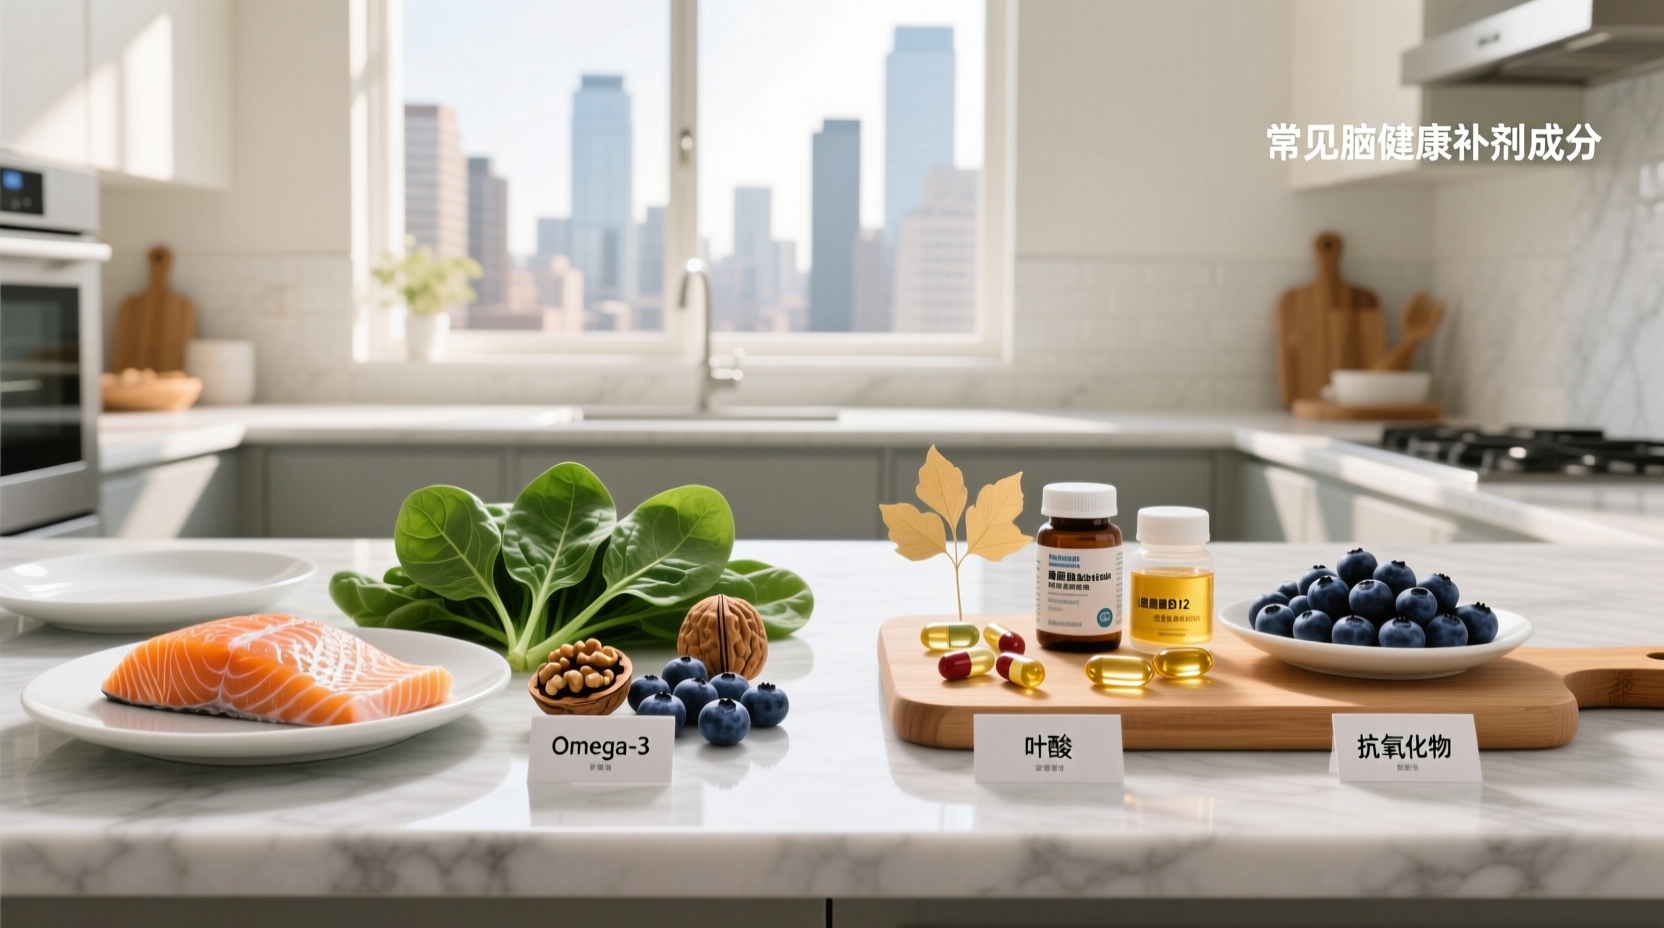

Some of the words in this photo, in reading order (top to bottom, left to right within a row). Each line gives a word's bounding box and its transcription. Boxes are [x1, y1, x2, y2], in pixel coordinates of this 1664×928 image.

[552, 735, 650, 761] Omega-3
[1025, 733, 1072, 760] 叶酸
[1357, 733, 1451, 760] 抗氧化物
